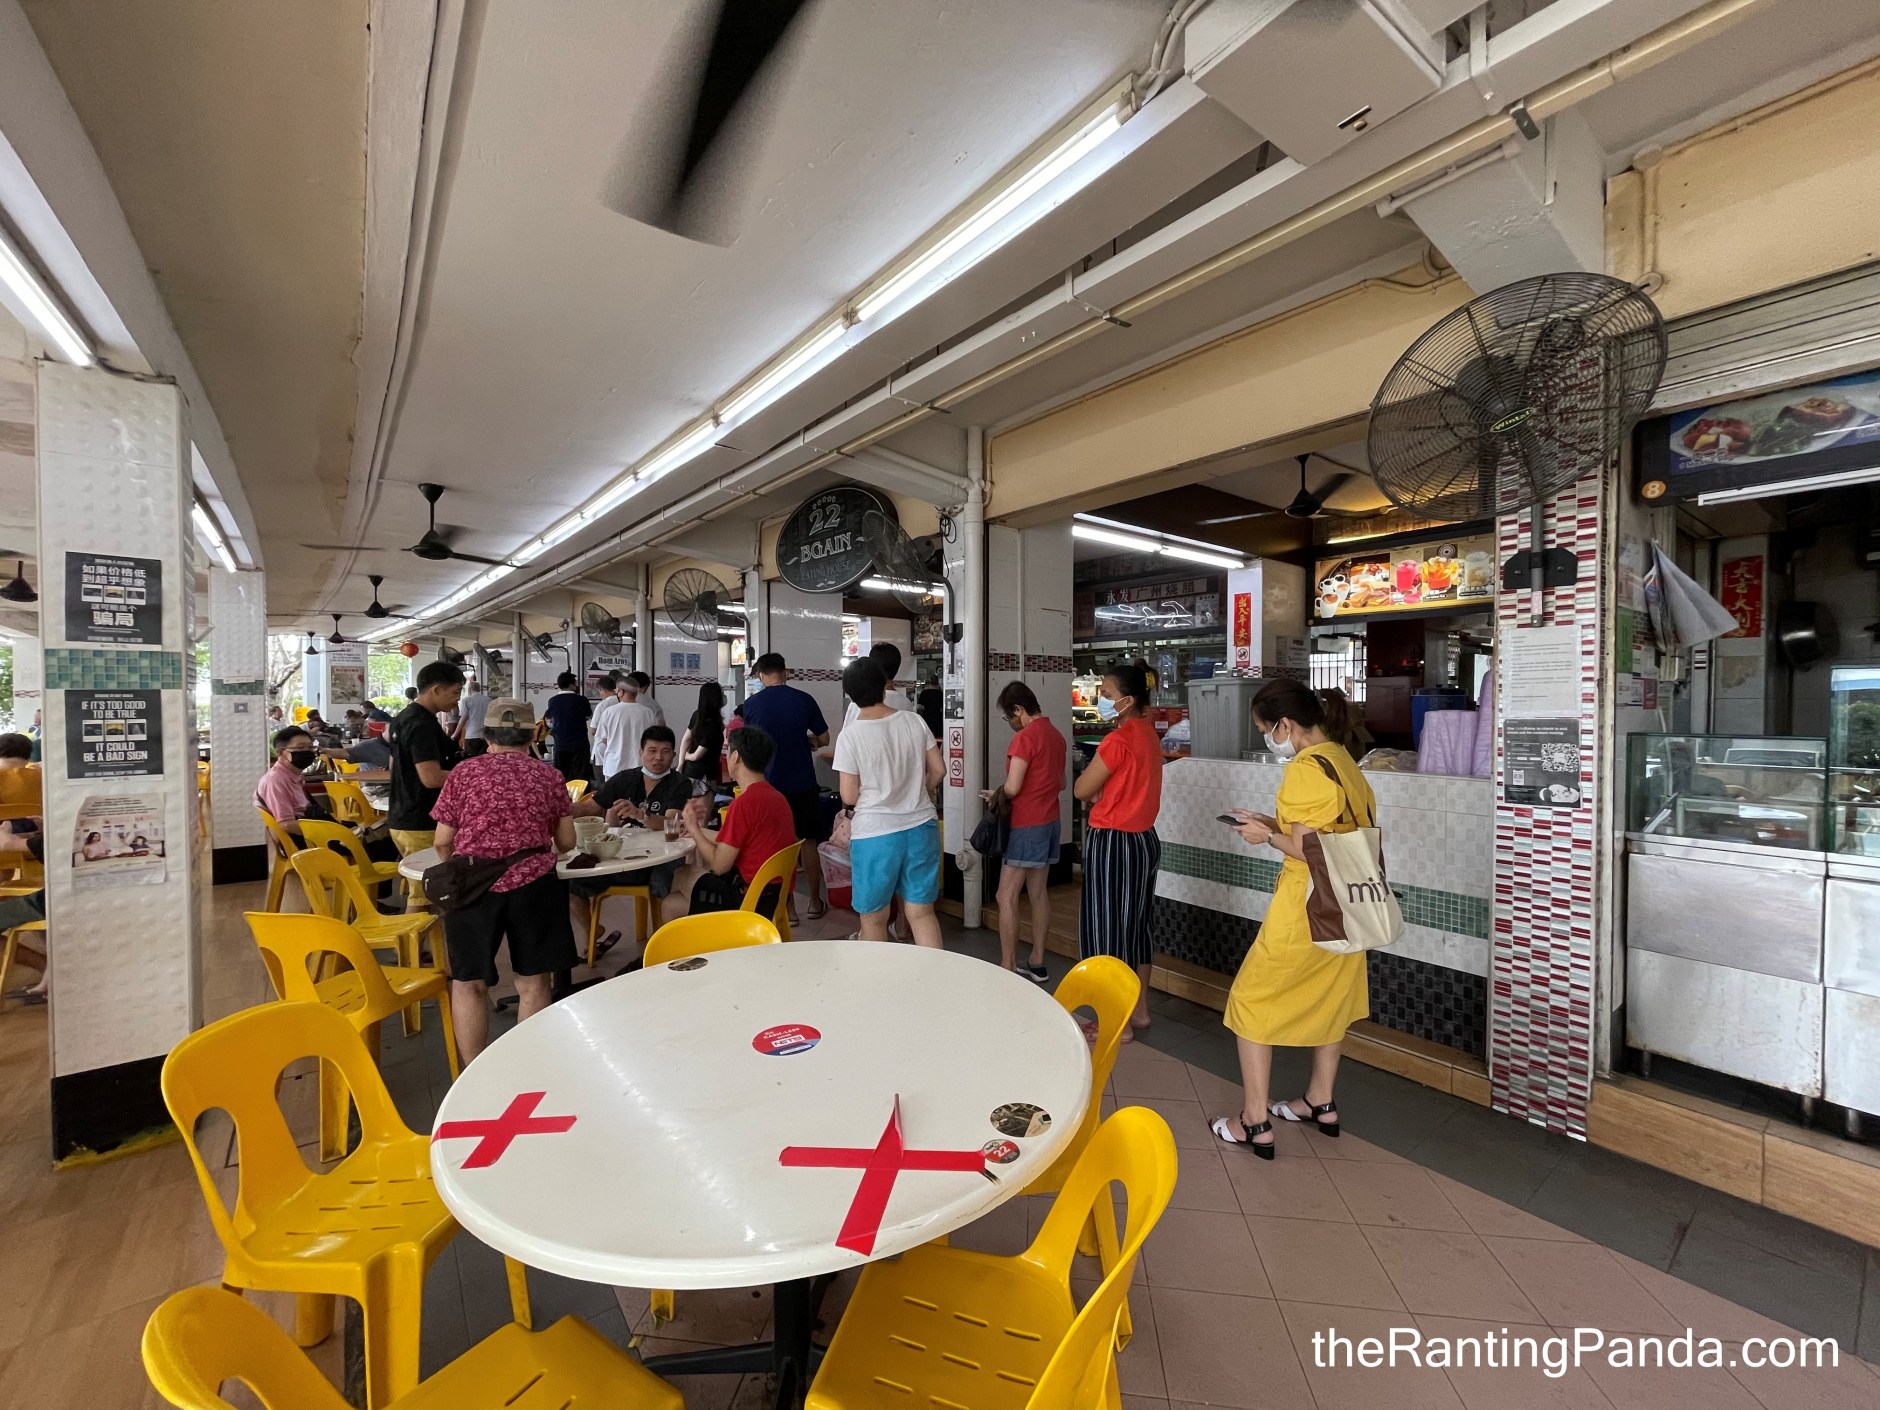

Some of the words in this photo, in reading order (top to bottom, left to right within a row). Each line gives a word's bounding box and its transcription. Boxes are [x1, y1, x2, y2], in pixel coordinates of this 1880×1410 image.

[1647, 482, 1660, 498] 8
[809, 504, 841, 536] 22
[800, 532, 852, 563] BGAIN
[82, 564, 147, 578] 如果价格低
[802, 567, 826, 580] EATING
[827, 560, 850, 577] HOUSE
[93, 611, 135, 627] 骗局
[82, 701, 89, 710] IF
[90, 701, 106, 710] IT'S
[107, 701, 123, 710] TOO
[124, 700, 146, 709] GOOD
[93, 710, 103, 719] TO
[105, 710, 115, 719] BE
[117, 709, 137, 718] TRUE
[96, 743, 104, 752] IT
[106, 742, 135, 751] COULD
[83, 753, 96, 763] BE
[98, 753, 104, 762] A
[105, 752, 125, 762] BAD
[126, 750, 148, 760] SIGN
[993, 1145, 1011, 1158] 22
